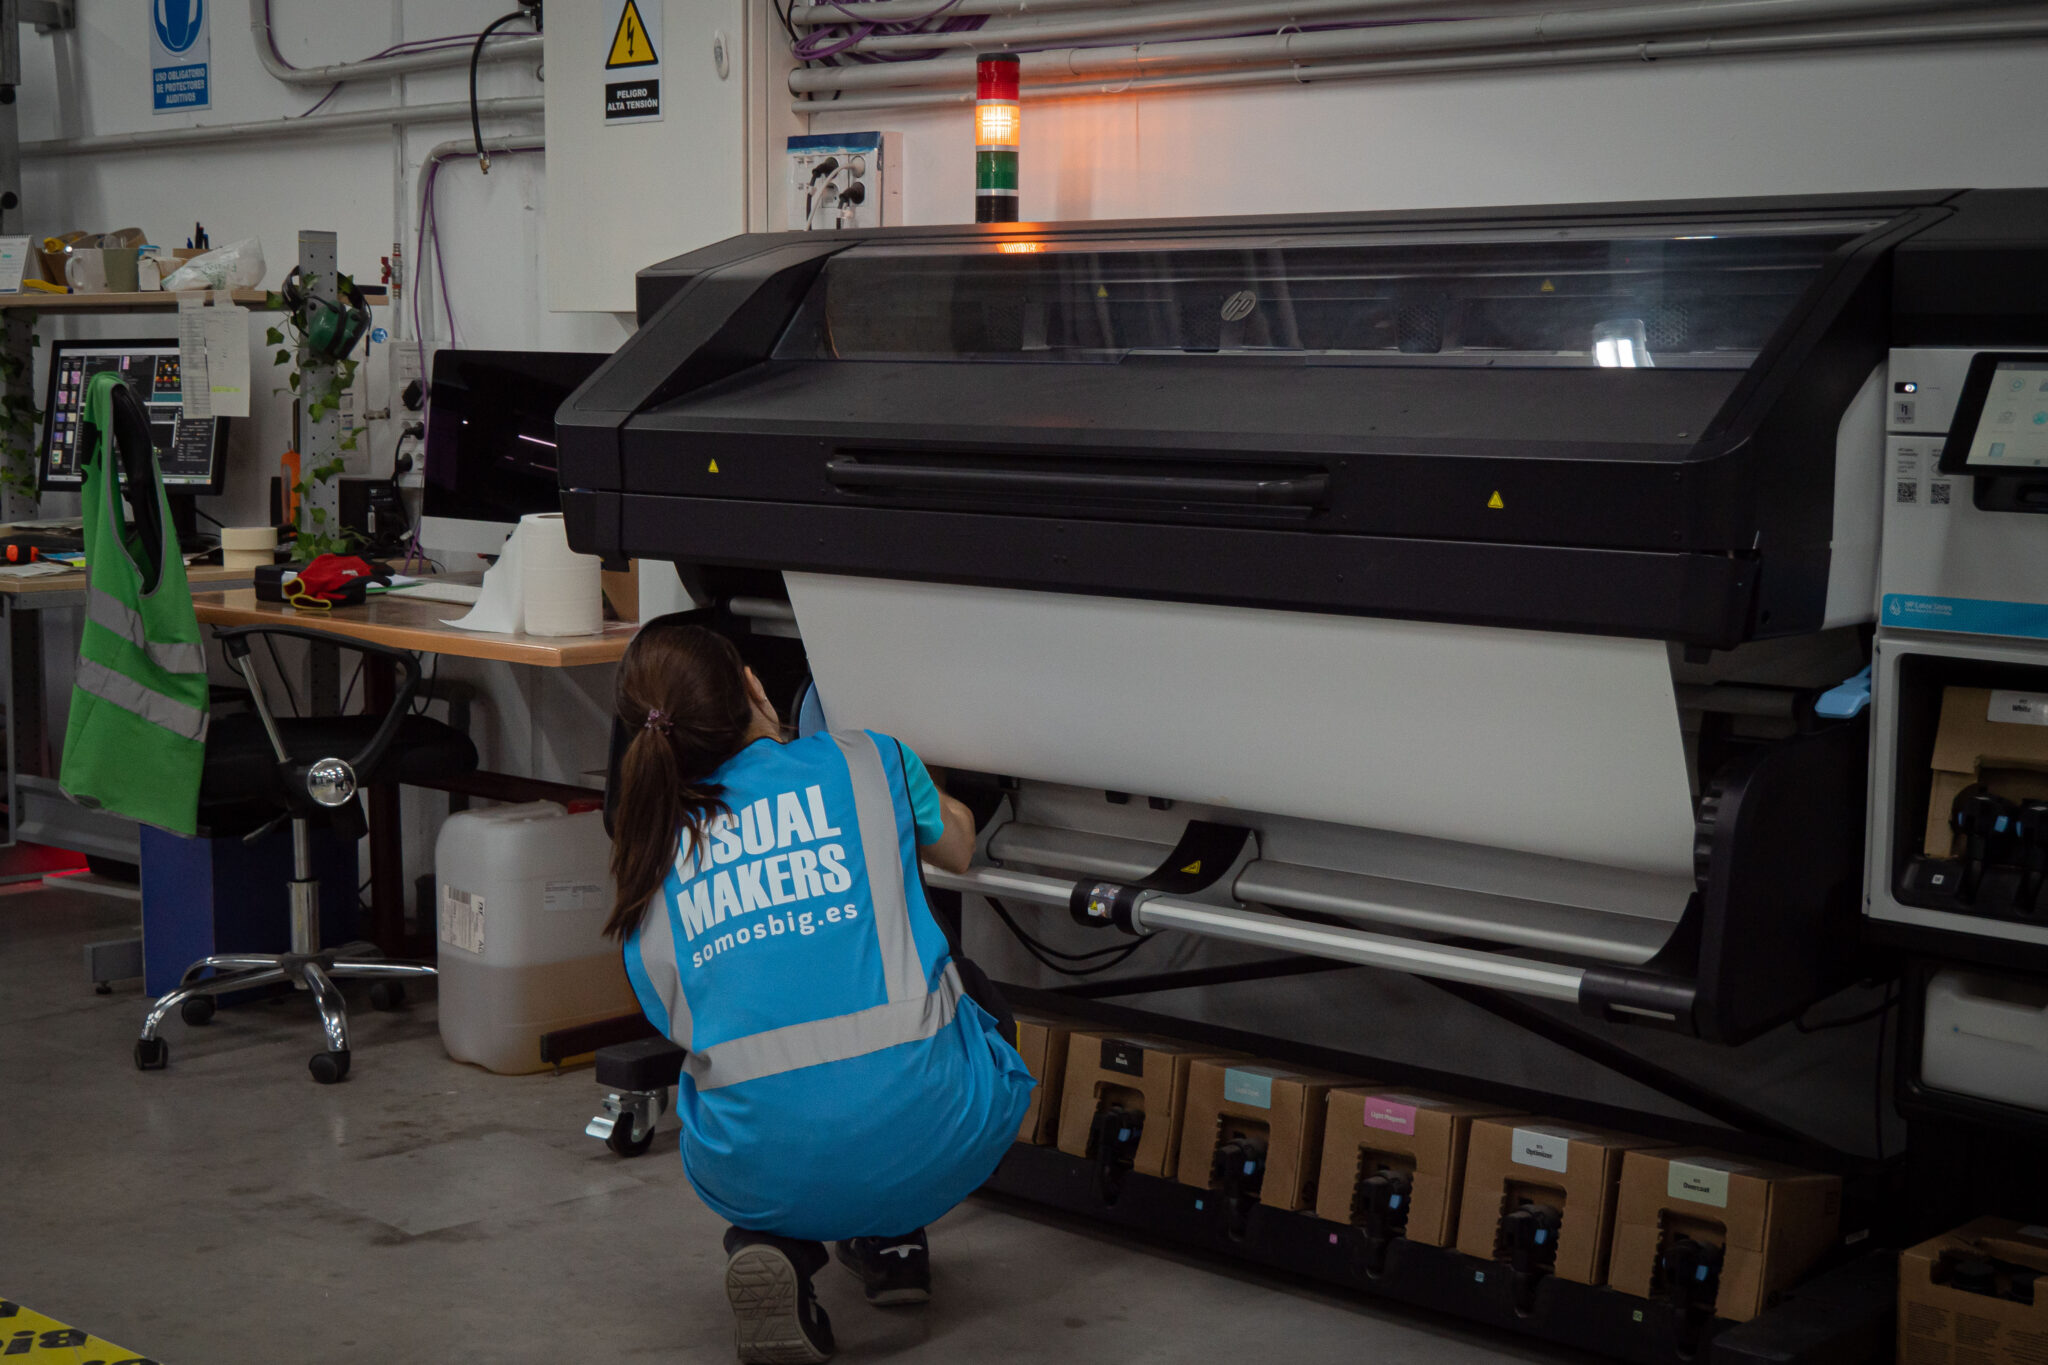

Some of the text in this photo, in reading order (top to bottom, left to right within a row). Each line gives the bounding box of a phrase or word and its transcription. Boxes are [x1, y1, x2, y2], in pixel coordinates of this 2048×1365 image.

[155, 67, 206, 82] USO OBLIGATORIO
[156, 79, 205, 94] DE PROTECTORES
[616, 88, 648, 99] PELIGRO
[165, 92, 196, 104] AUDITIVOS
[607, 98, 658, 111] ALTA TENSIÓN
[676, 843, 851, 942] MAKERS
[692, 903, 858, 968] somosbig.es
